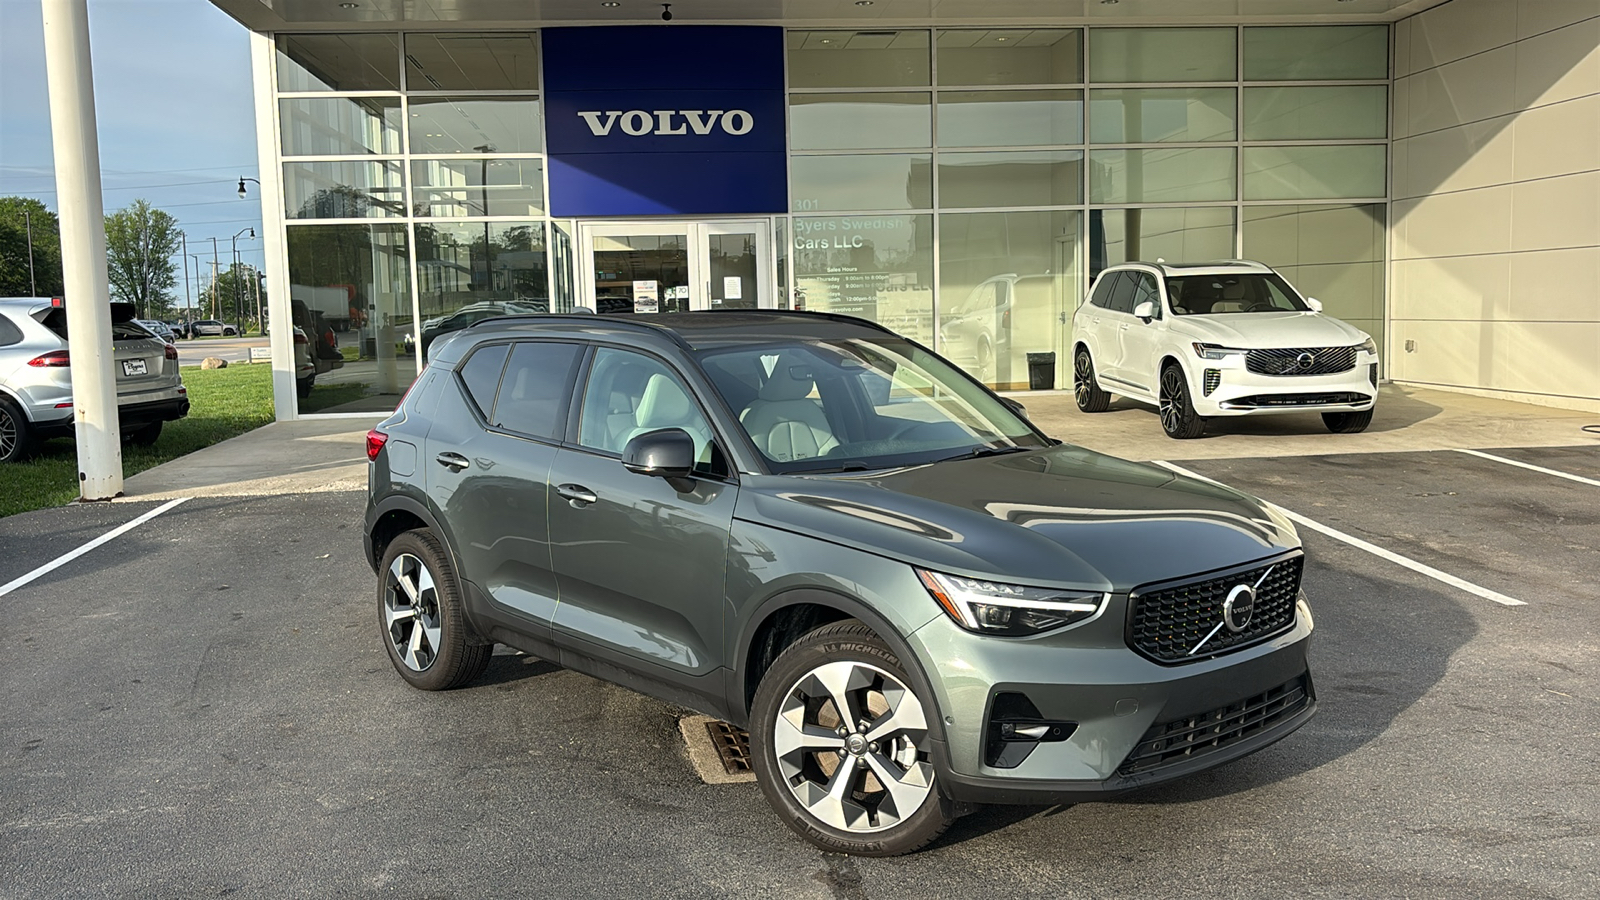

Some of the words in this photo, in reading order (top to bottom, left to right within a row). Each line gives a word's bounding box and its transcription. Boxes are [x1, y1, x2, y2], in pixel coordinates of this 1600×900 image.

[577, 109, 754, 136] VOLVO
[795, 199, 818, 210] 301
[795, 218, 836, 234] Byers
[841, 218, 904, 230] Swedish
[794, 236, 829, 249] Cars
[834, 235, 863, 248] LLC
[840, 643, 899, 664] MICHELIN
